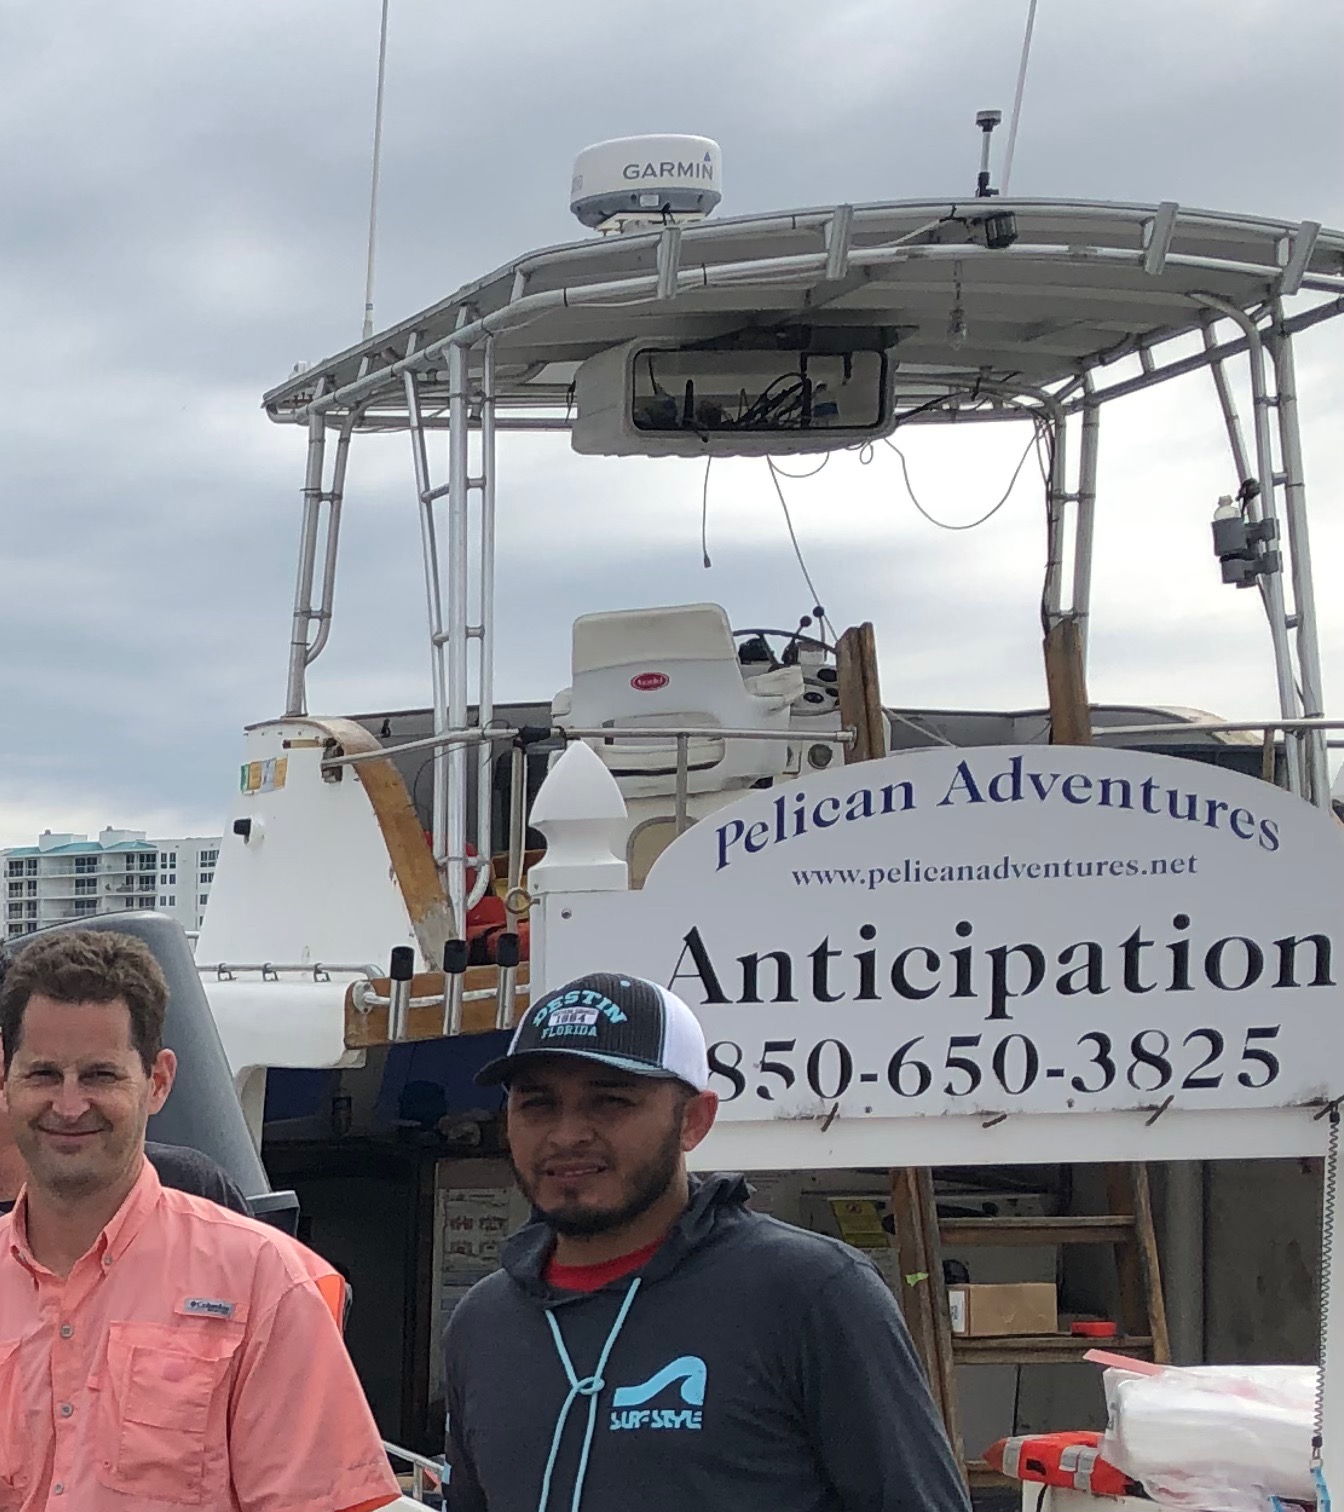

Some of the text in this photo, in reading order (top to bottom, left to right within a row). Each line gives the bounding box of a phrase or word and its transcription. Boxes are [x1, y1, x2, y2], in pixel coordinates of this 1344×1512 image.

[623, 161, 713, 181] GARMIN
[714, 756, 1282, 873] Pelican Adventures
[791, 854, 1199, 890] www.pelicanadventures.net
[666, 914, 1337, 1021] Anticipation
[532, 990, 628, 1027] DESTIN
[541, 1025, 597, 1039] FLORIDA
[708, 1028, 1281, 1102] 850-650-3825
